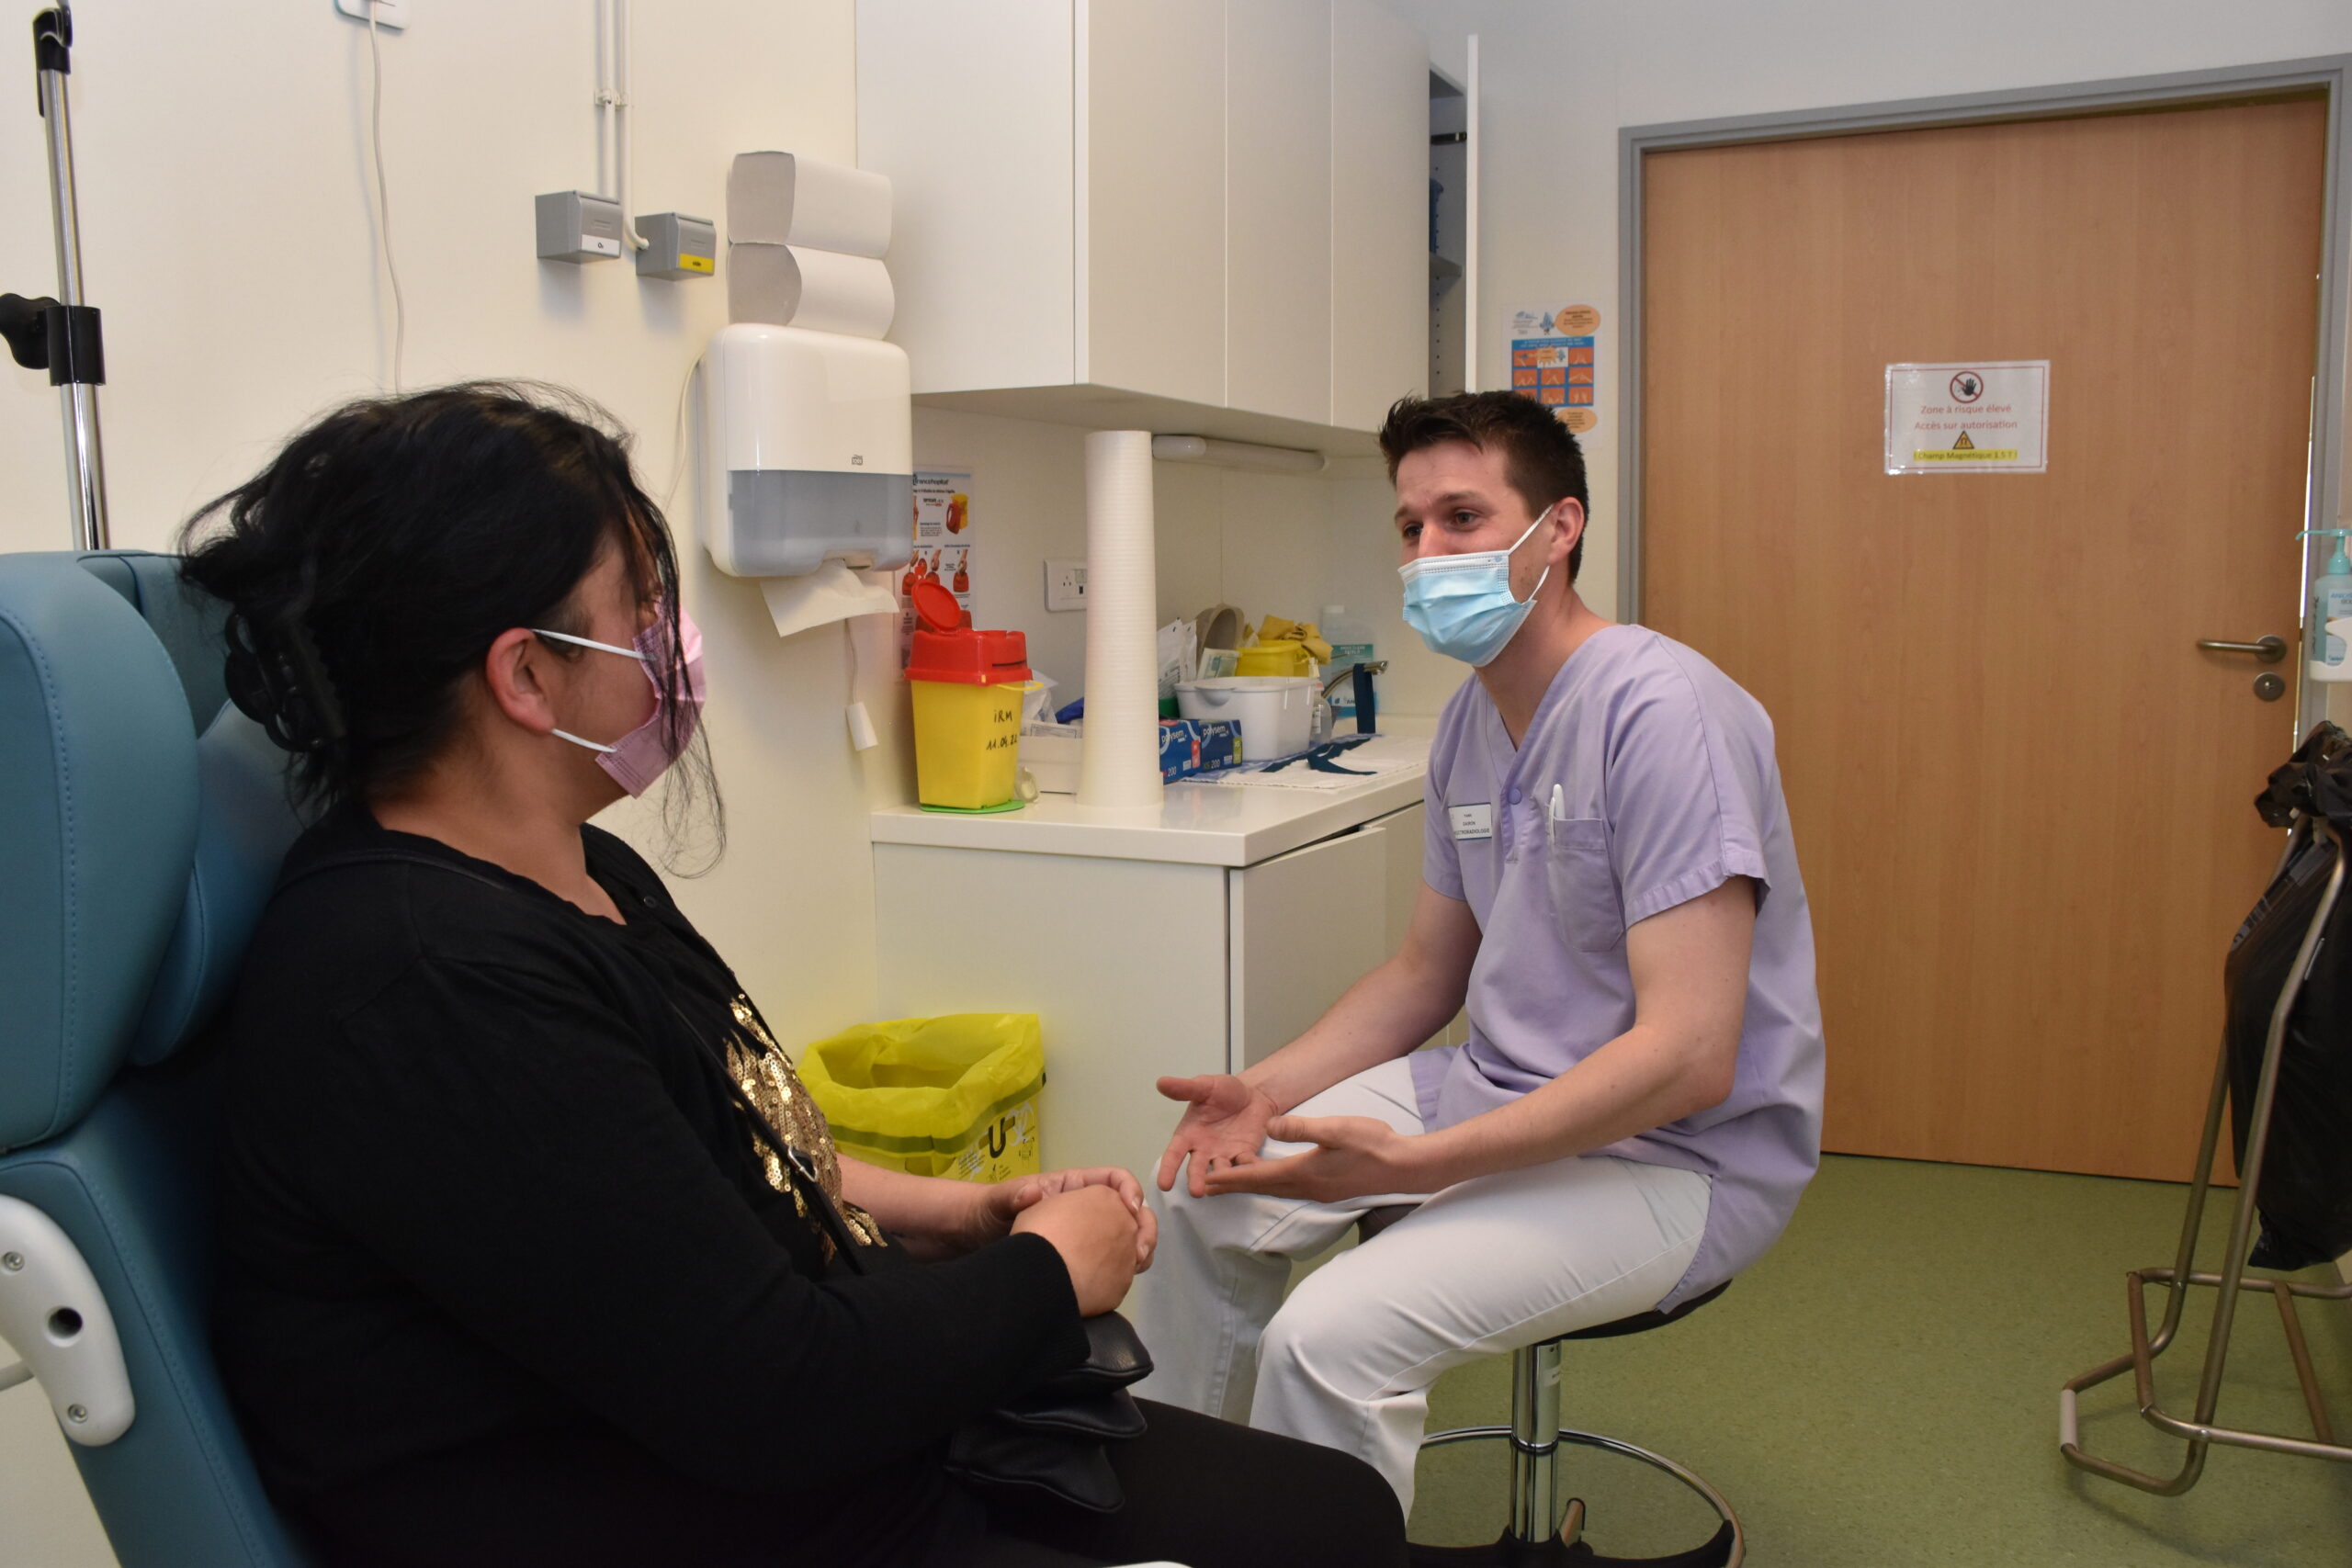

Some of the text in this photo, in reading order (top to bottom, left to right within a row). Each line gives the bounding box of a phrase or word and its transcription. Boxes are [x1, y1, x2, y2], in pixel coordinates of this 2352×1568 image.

[1920, 404, 2011, 414] Zone à risque élevé
[1915, 421, 1940, 430] Accès
[1960, 421, 2018, 430] autorisation
[1917, 450, 1945, 461] Champ
[1947, 450, 1992, 460] Magnétique
[1161, 729, 1184, 744] polysem
[1203, 725, 1226, 738] polysem
[1211, 759, 1221, 770] 200
[1167, 766, 1177, 778] 200
